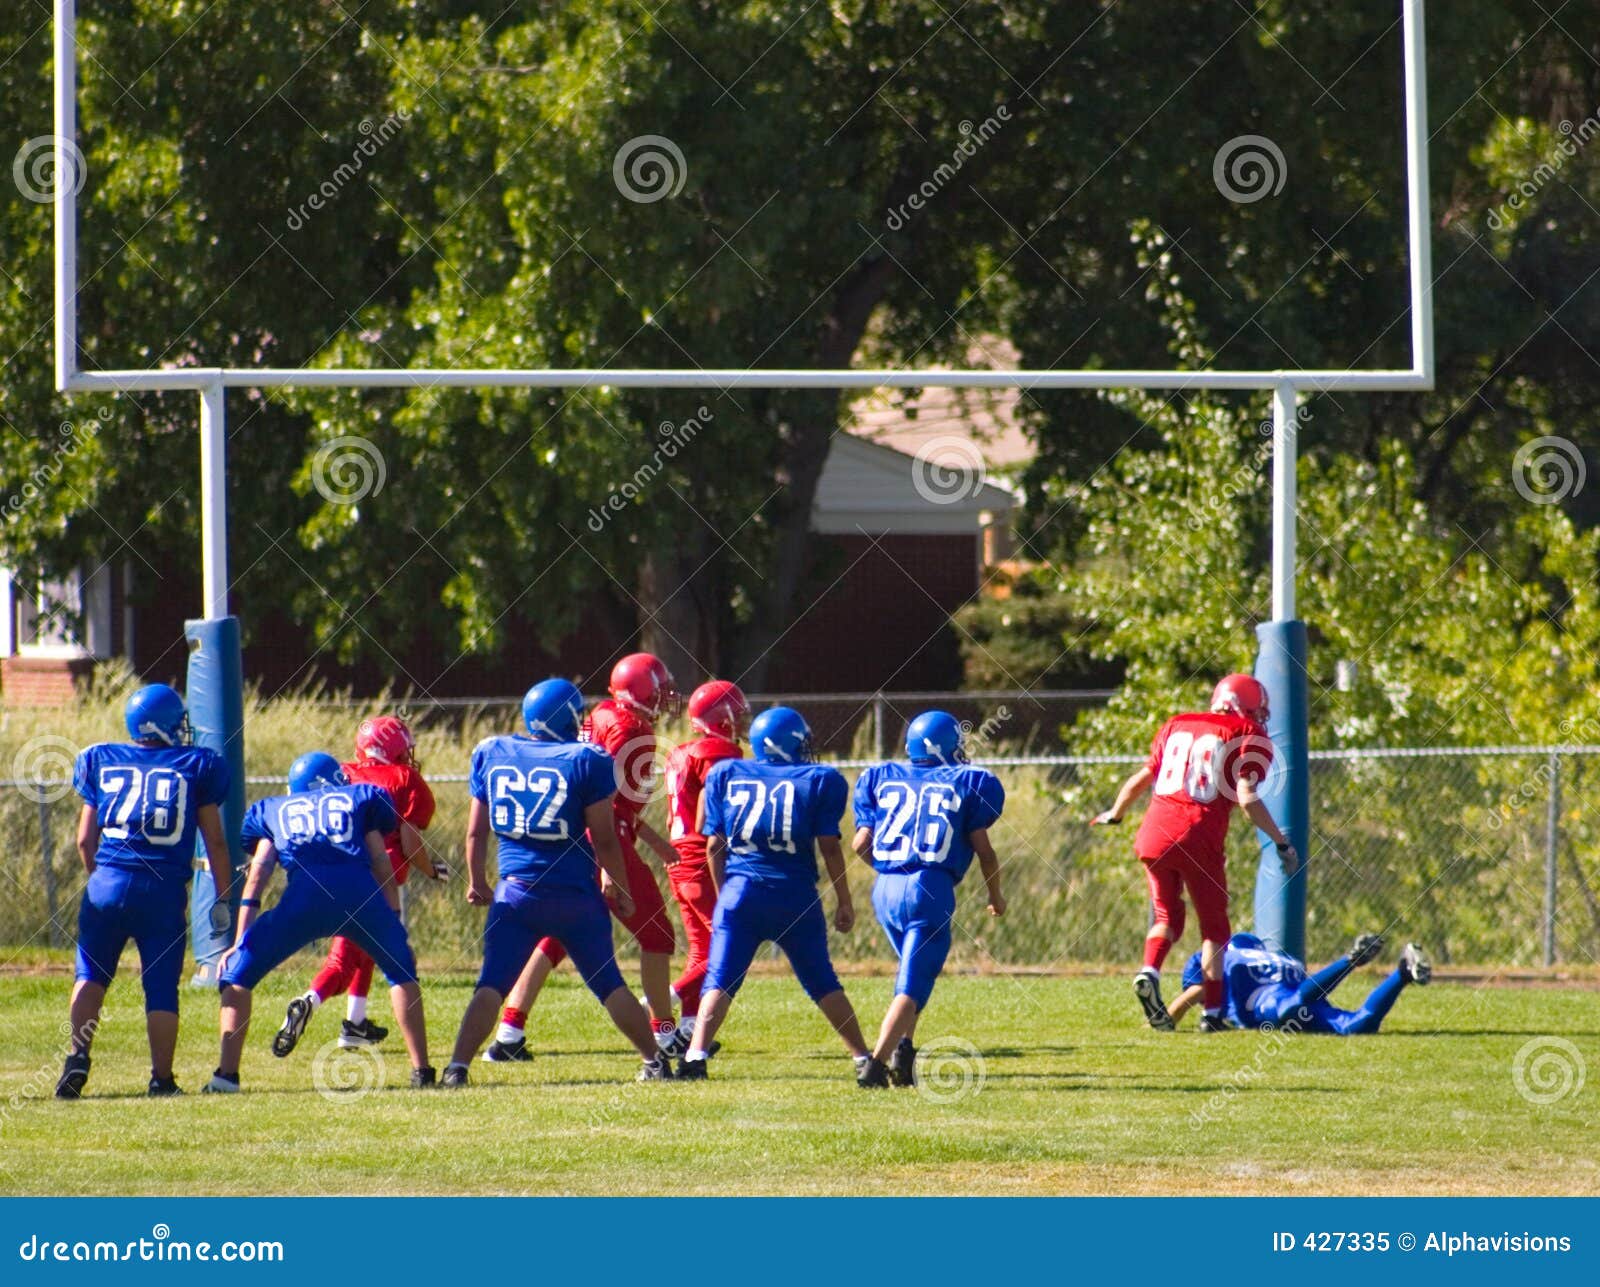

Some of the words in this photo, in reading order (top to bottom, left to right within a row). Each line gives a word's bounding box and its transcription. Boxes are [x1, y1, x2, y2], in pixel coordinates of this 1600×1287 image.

[487, 765, 568, 841] 62
[1154, 731, 1225, 804] 88
[99, 766, 188, 846] 78
[278, 792, 354, 846] 66
[726, 780, 796, 855] 71
[872, 781, 962, 863] 26
